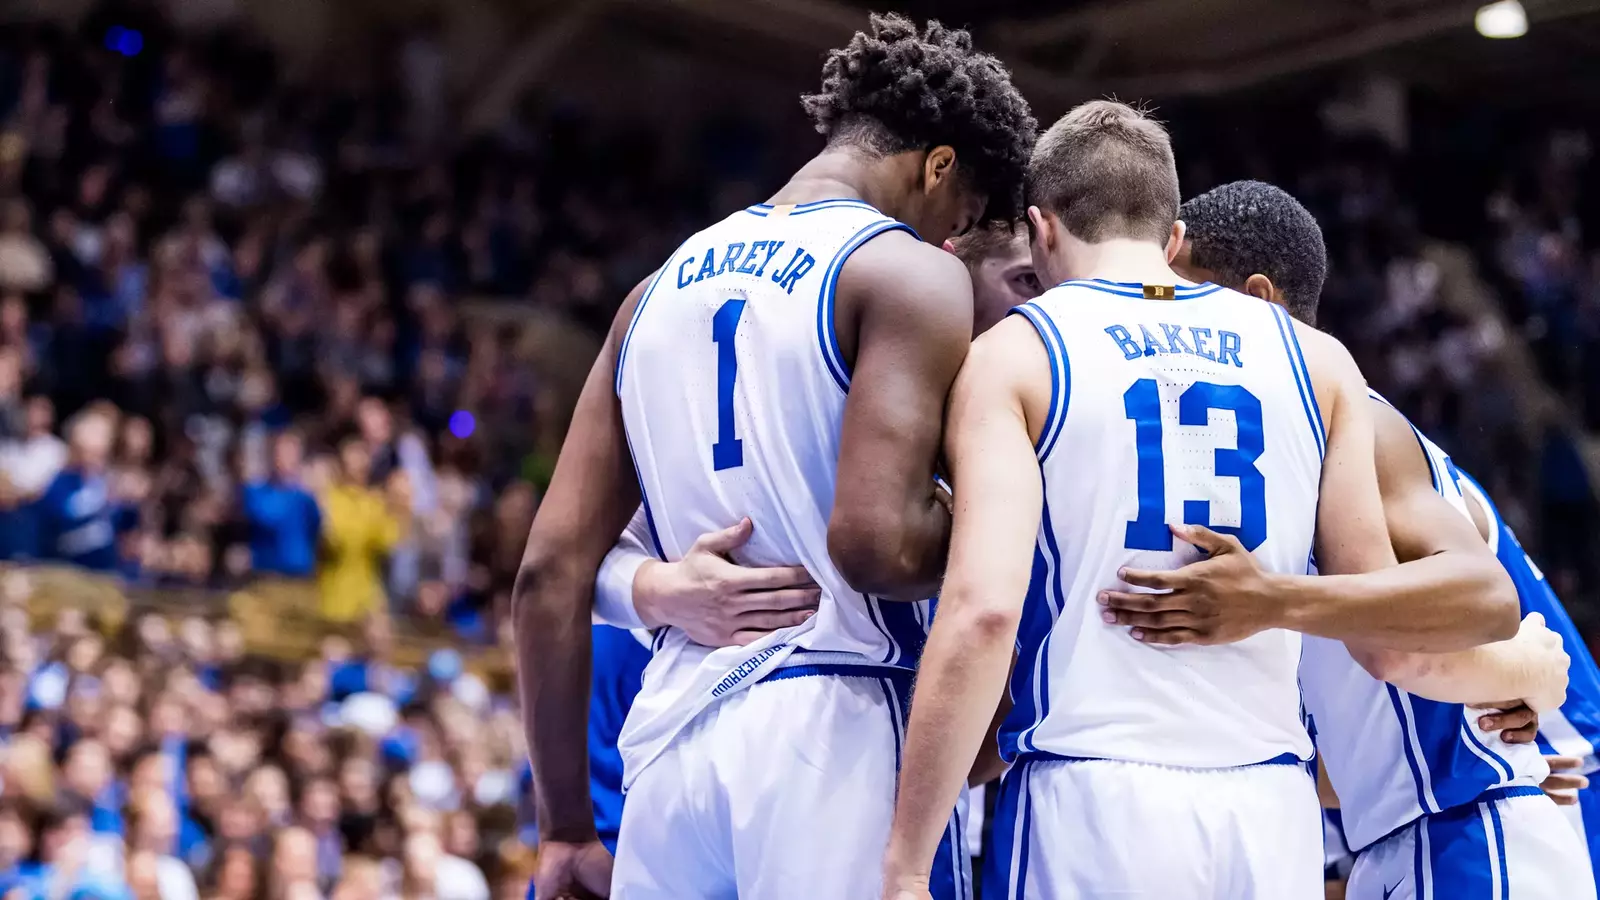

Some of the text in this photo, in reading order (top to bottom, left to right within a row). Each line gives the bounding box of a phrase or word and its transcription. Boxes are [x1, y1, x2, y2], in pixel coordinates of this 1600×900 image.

[677, 240, 816, 294] CAREY JR
[712, 298, 747, 471] 1
[1104, 322, 1243, 368] BAKER
[1123, 378, 1267, 553] 13
